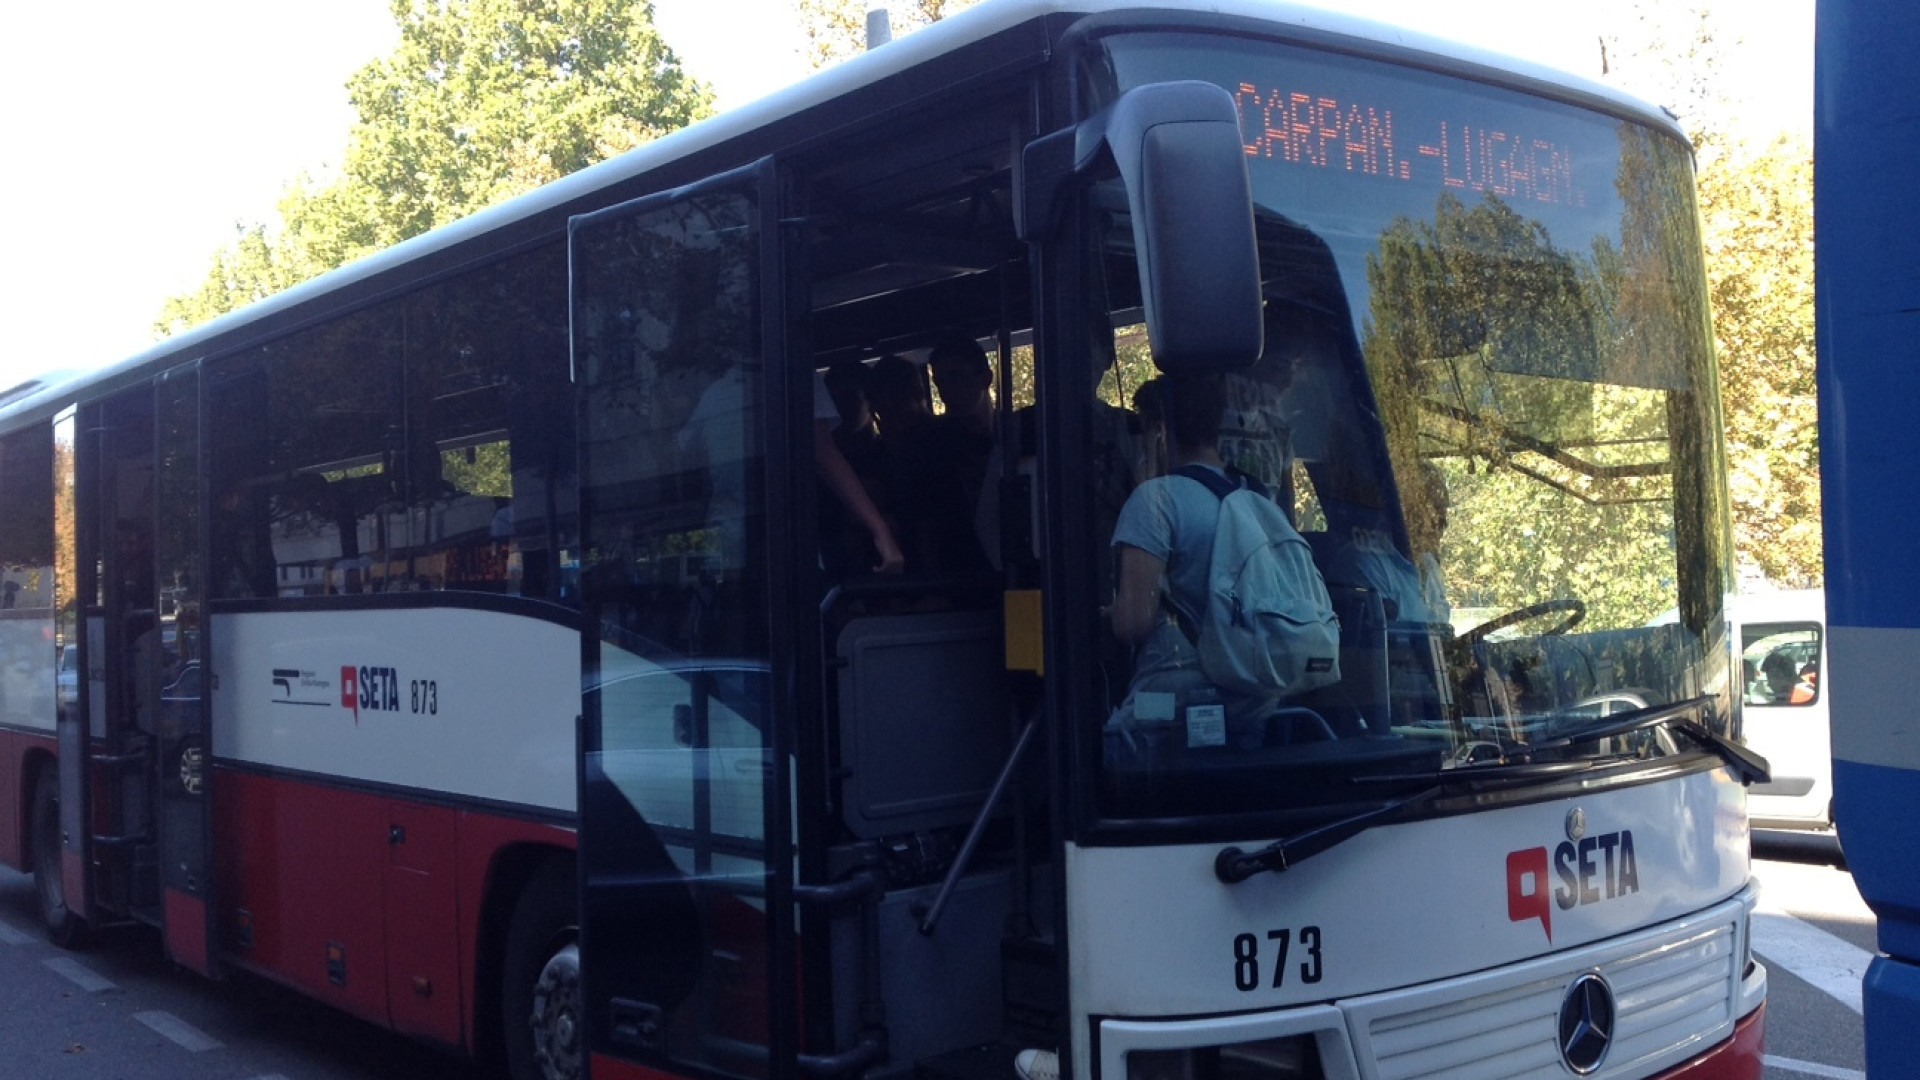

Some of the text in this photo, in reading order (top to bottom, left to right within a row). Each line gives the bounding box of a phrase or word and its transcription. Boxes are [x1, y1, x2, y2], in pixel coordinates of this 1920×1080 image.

[360, 666, 438, 715] SETA 873
[1554, 830, 1639, 910] SETA
[1234, 926, 1323, 992] 873
